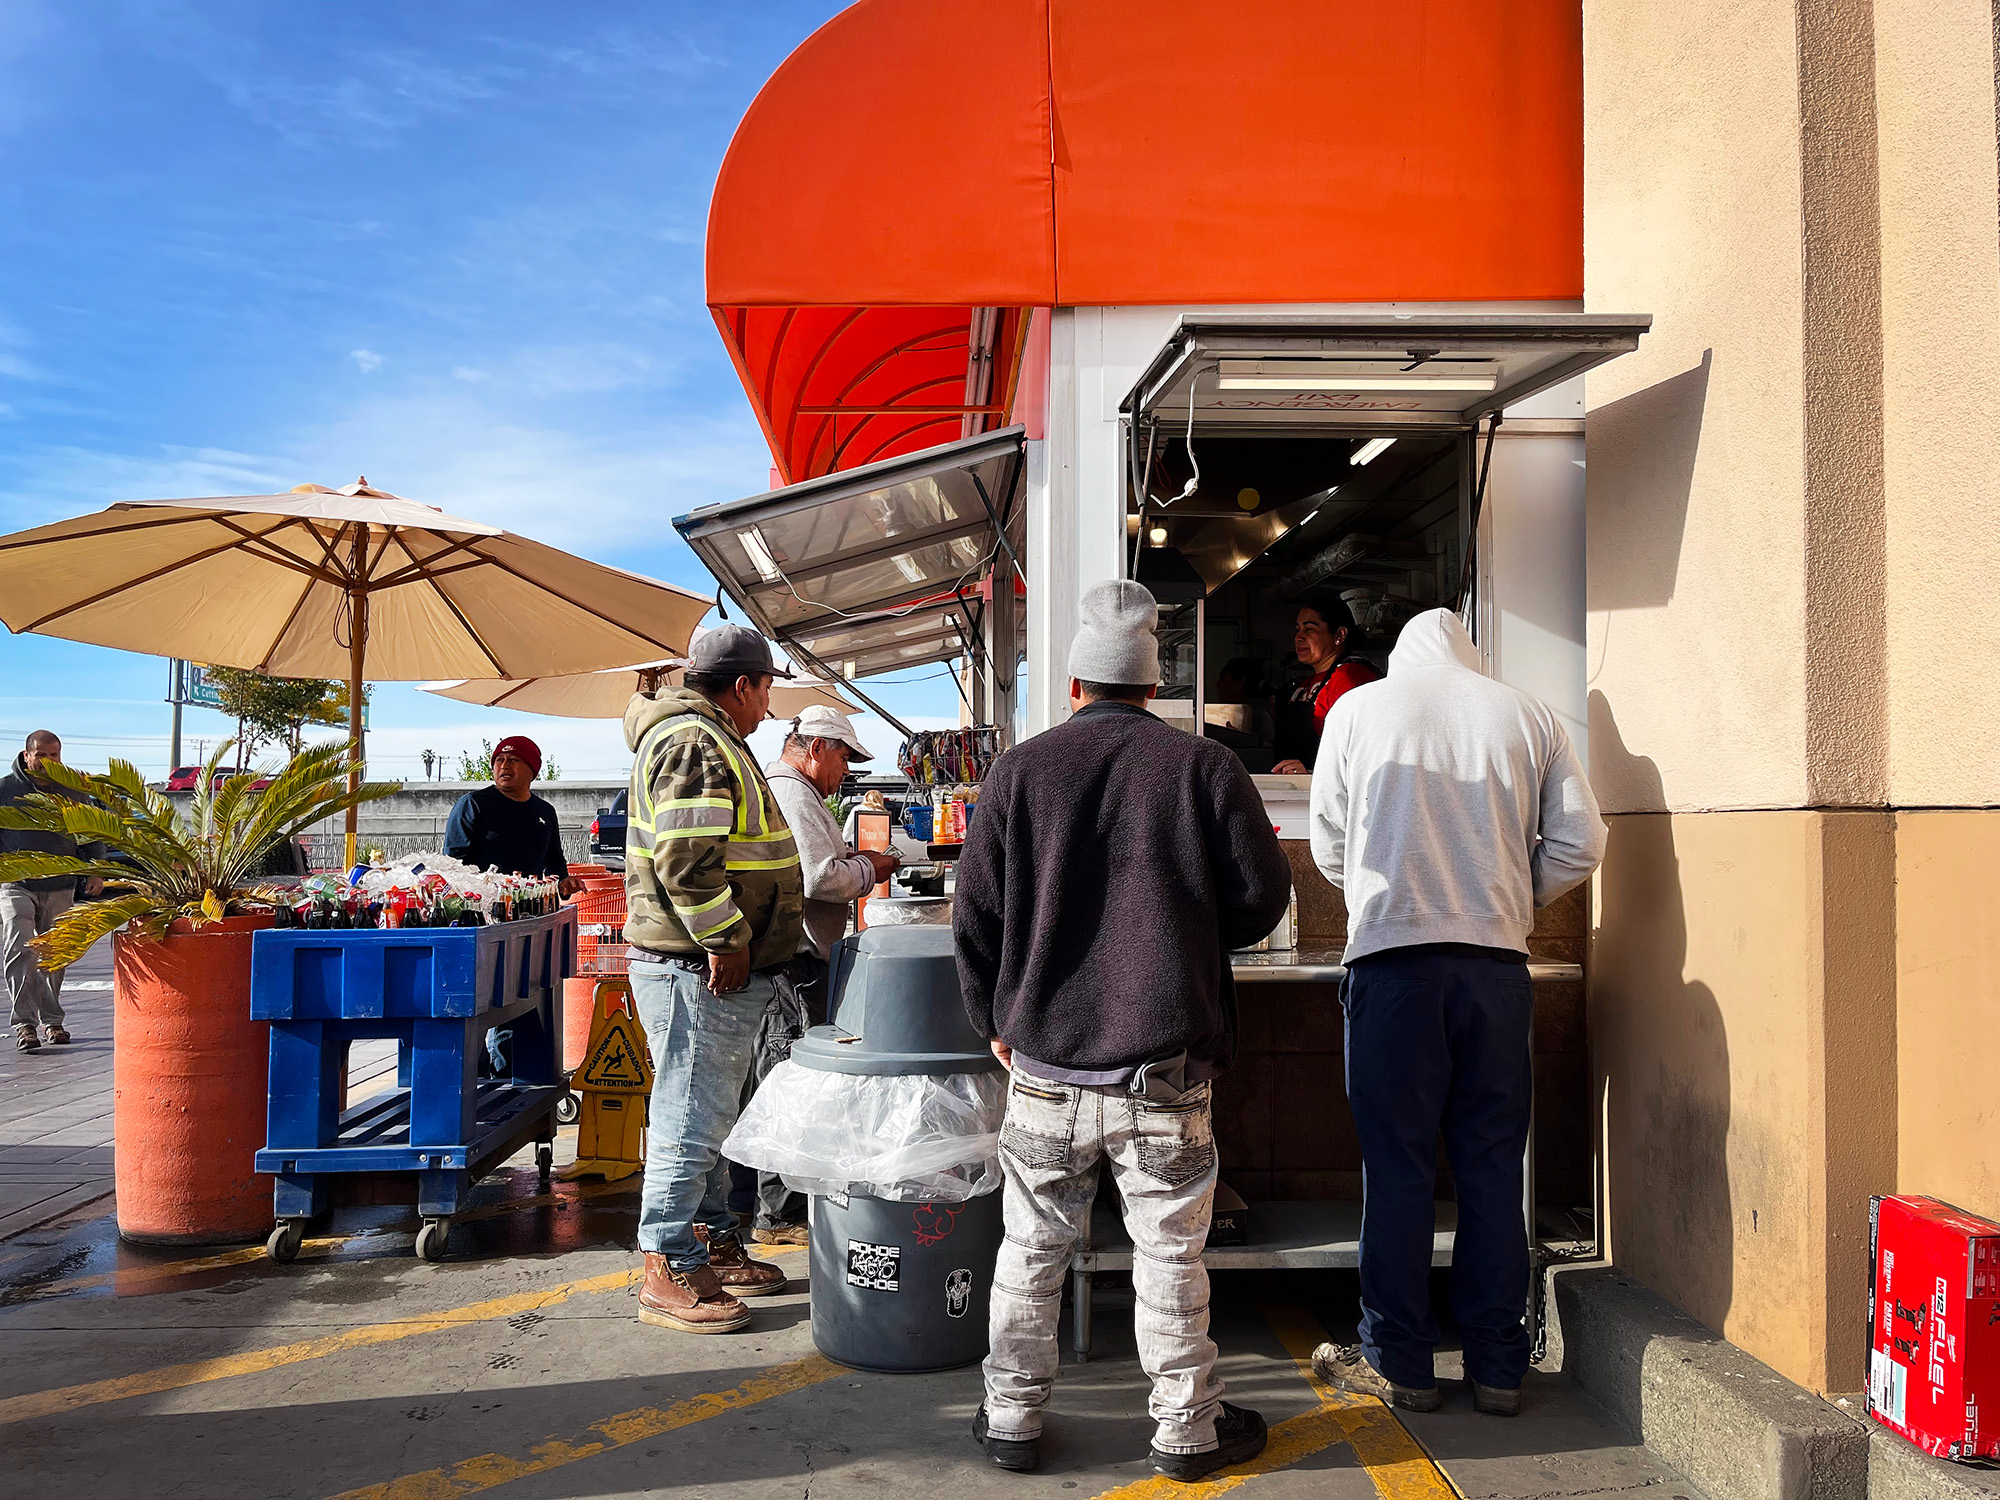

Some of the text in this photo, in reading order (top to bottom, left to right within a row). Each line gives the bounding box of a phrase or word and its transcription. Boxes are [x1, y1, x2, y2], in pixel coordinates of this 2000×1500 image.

[1206, 400, 1422, 409] EMERGENCY
[1286, 393, 1361, 401] EXIT
[860, 828, 888, 840] Thank You
[589, 1037, 612, 1071] CAUTION
[622, 1038, 642, 1073] CUIDADO
[593, 1078, 634, 1088] ATTENTION
[1932, 1278, 1946, 1405] M12 FUEL
[1965, 1393, 1975, 1443] FUEL
